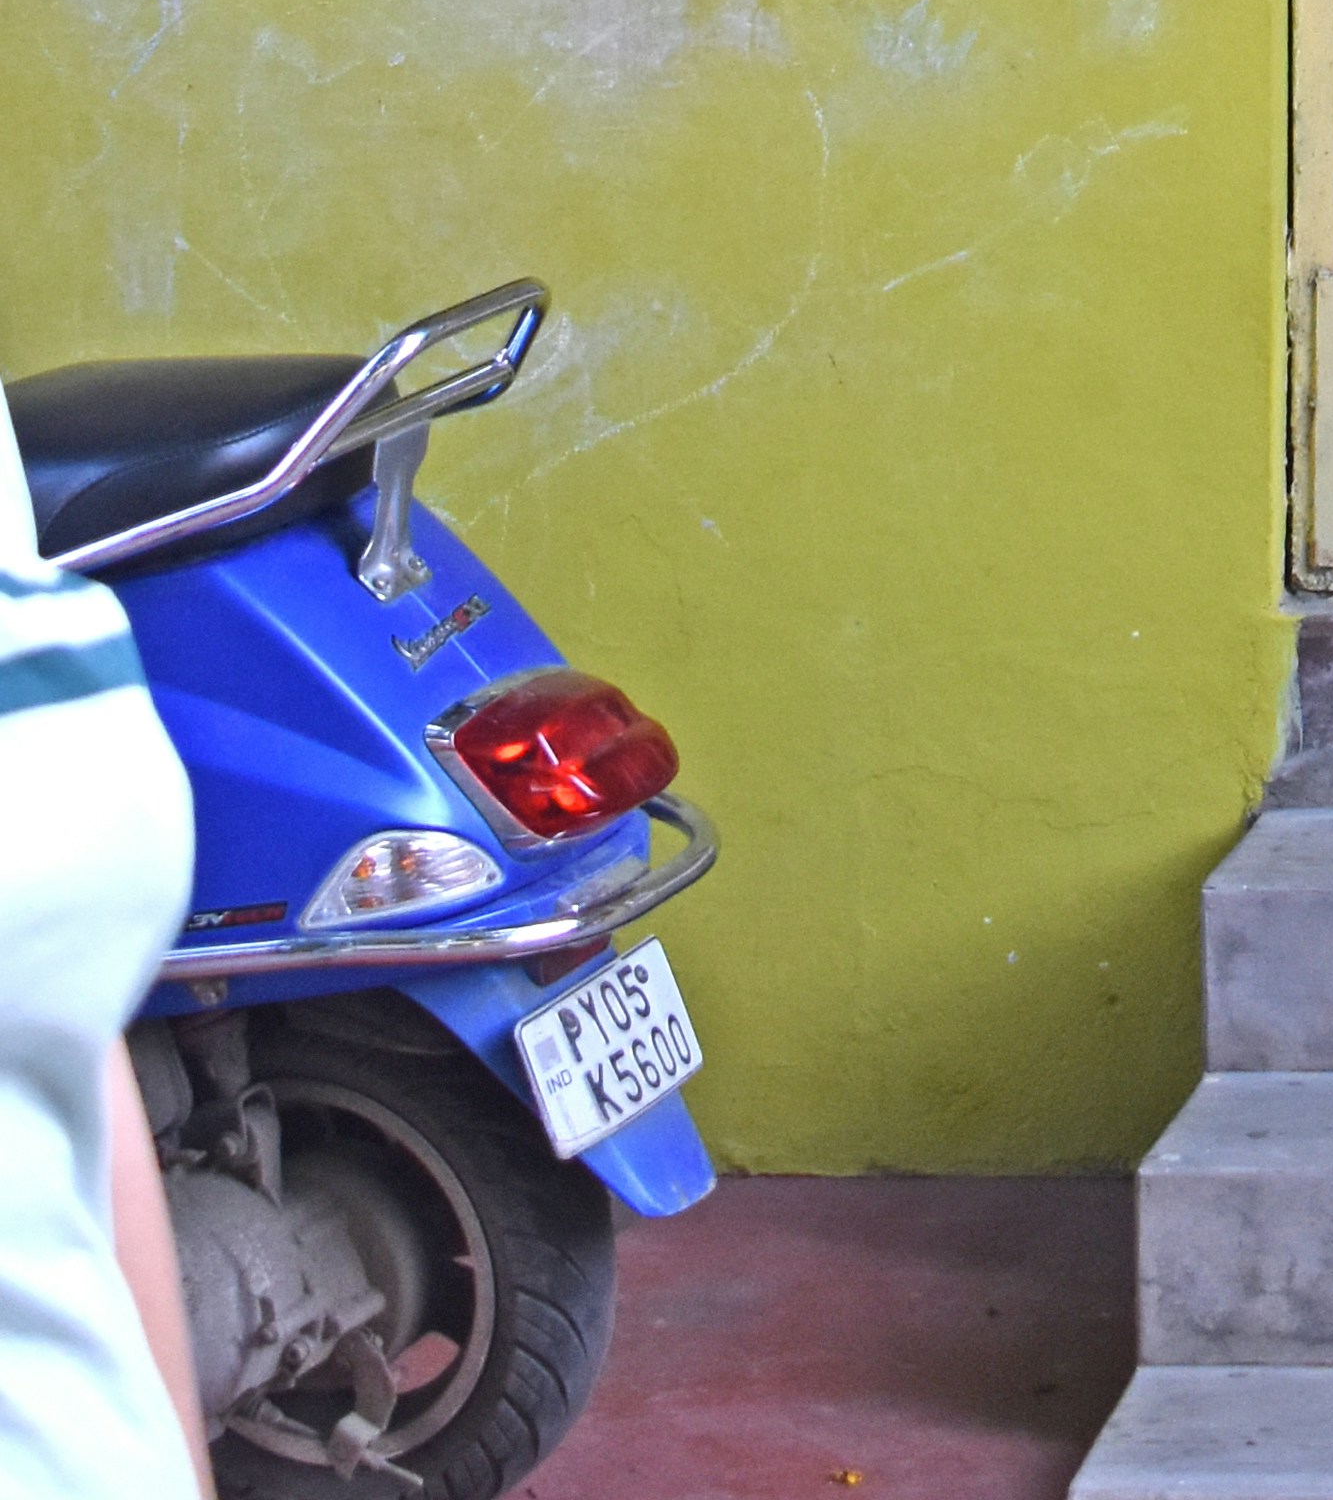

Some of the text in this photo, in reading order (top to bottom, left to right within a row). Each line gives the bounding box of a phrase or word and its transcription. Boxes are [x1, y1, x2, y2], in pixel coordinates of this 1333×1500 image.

[557, 964, 651, 1063] PY05
[545, 1068, 574, 1095] IND
[585, 1013, 692, 1123] K5600
